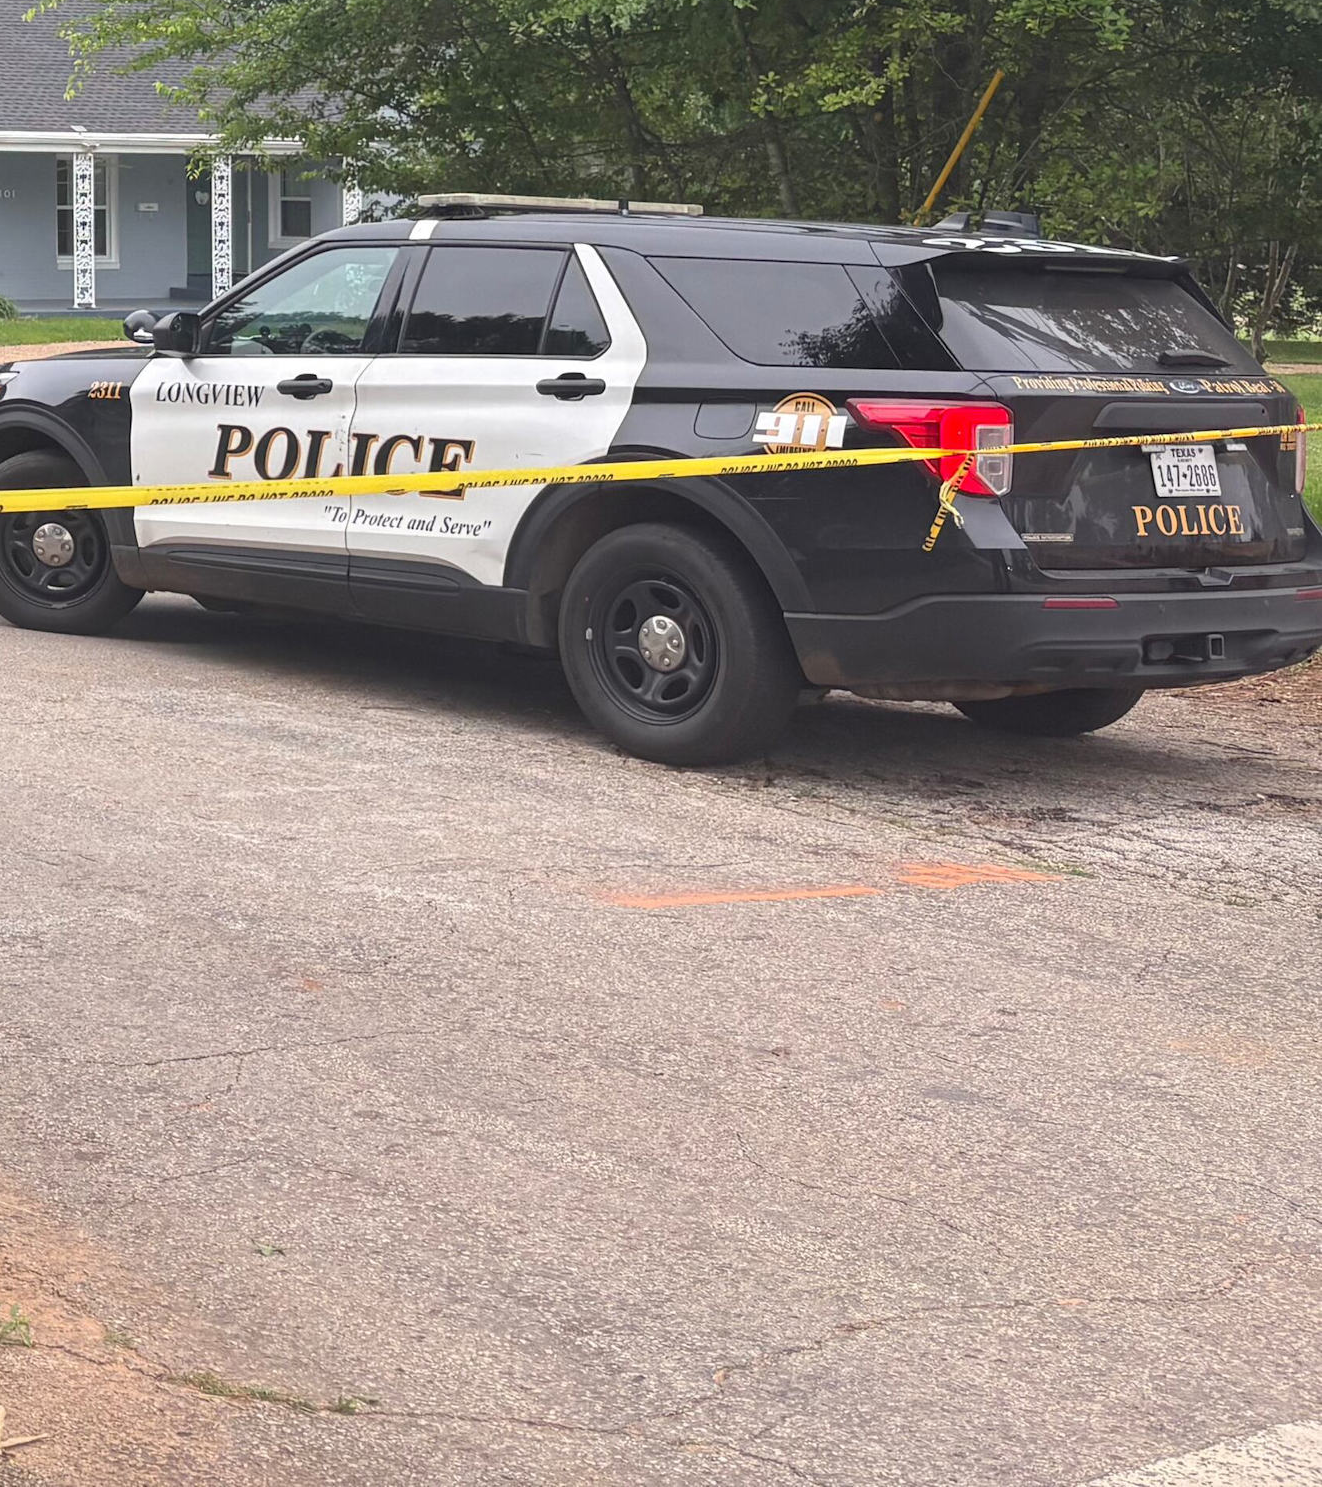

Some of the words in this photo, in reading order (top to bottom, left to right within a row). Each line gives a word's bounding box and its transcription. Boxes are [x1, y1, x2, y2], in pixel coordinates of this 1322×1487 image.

[87, 380, 124, 400] 2311
[155, 381, 265, 409] LONGVIEW
[1011, 375, 1075, 393] Providing
[794, 400, 816, 413] CALL
[208, 423, 476, 501] POLICE
[1169, 447, 1197, 458] TEXAS
[351, 508, 403, 531] Protect
[406, 513, 434, 532] and
[439, 515, 492, 538] Serve"
[1130, 504, 1246, 537] POLICE
